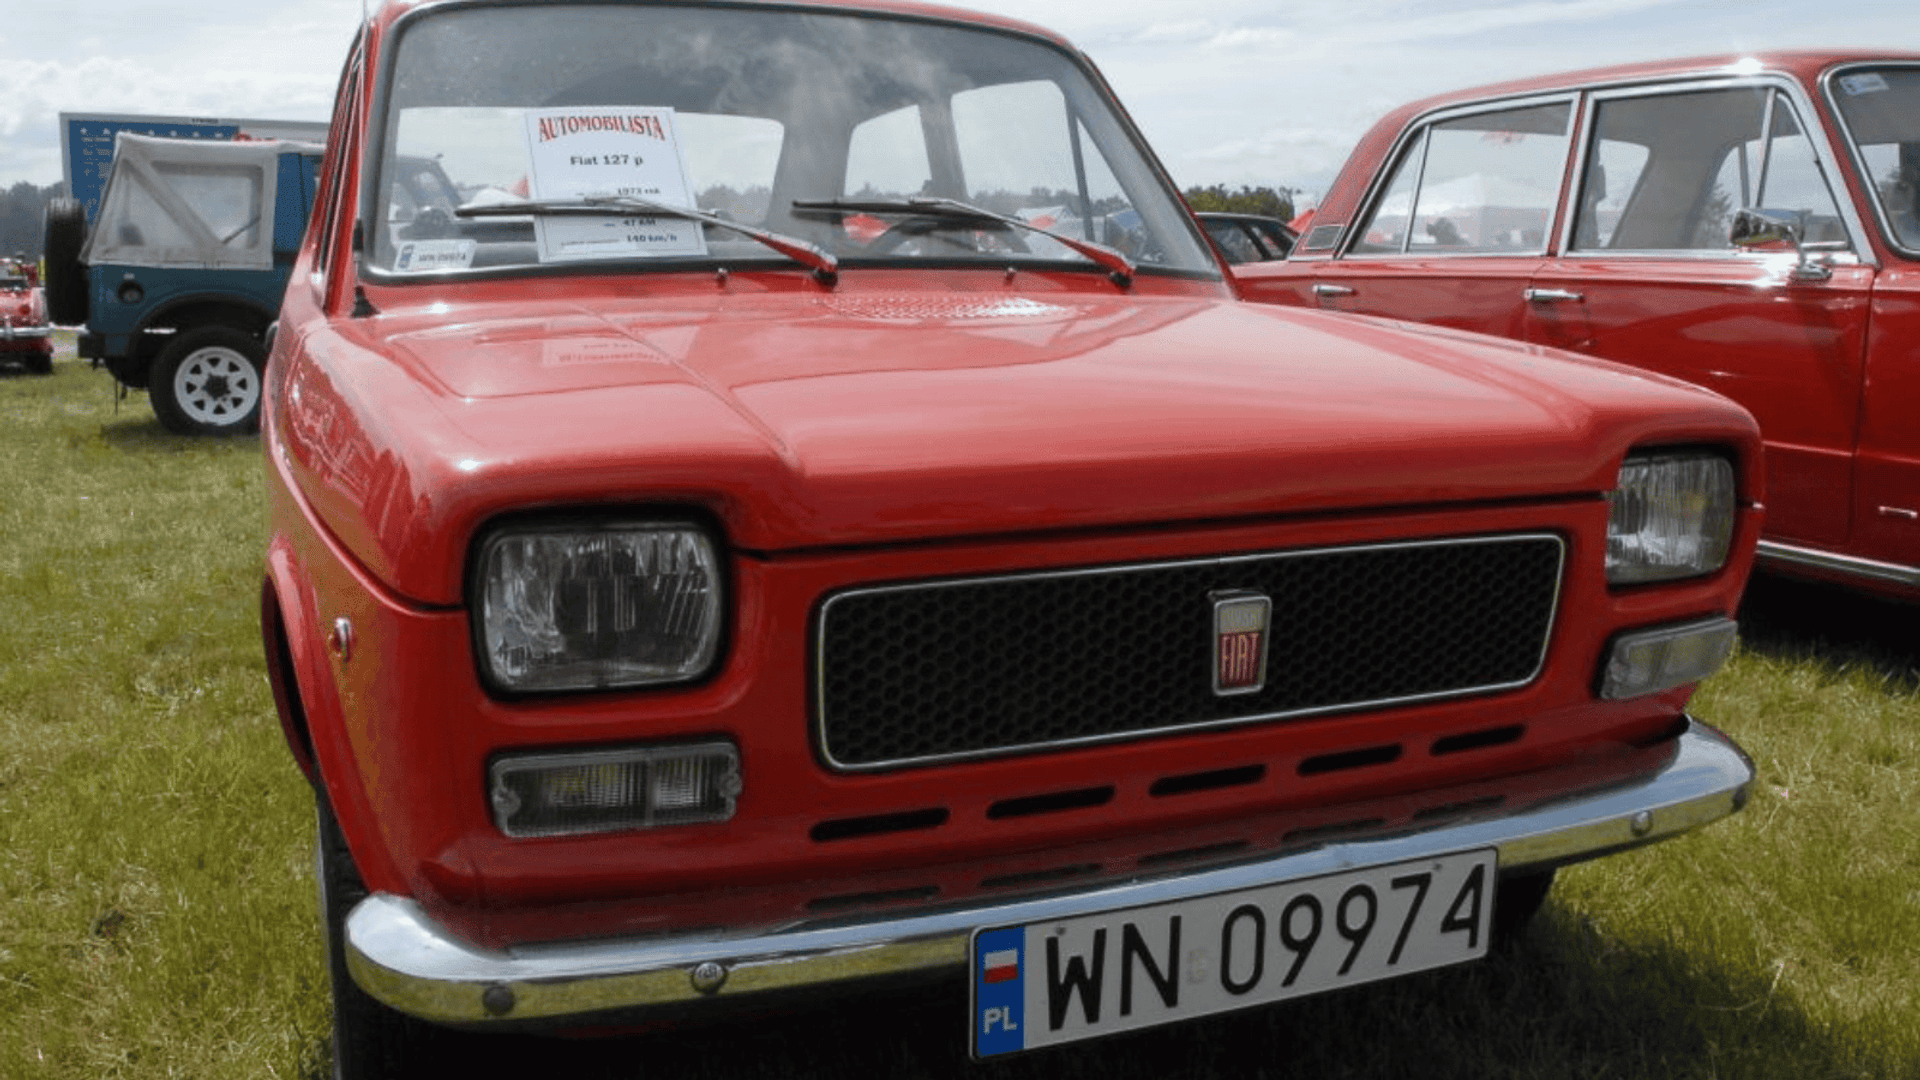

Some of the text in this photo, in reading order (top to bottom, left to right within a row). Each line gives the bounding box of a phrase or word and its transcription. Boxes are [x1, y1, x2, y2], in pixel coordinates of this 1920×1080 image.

[538, 115, 666, 143] AUTOMOBILISTA
[570, 155, 644, 167] Fiat 127 p
[627, 234, 646, 242] 140
[1221, 632, 1259, 682] FIAT
[1046, 863, 1486, 1032] WN 09974
[983, 1006, 1018, 1035] PL
